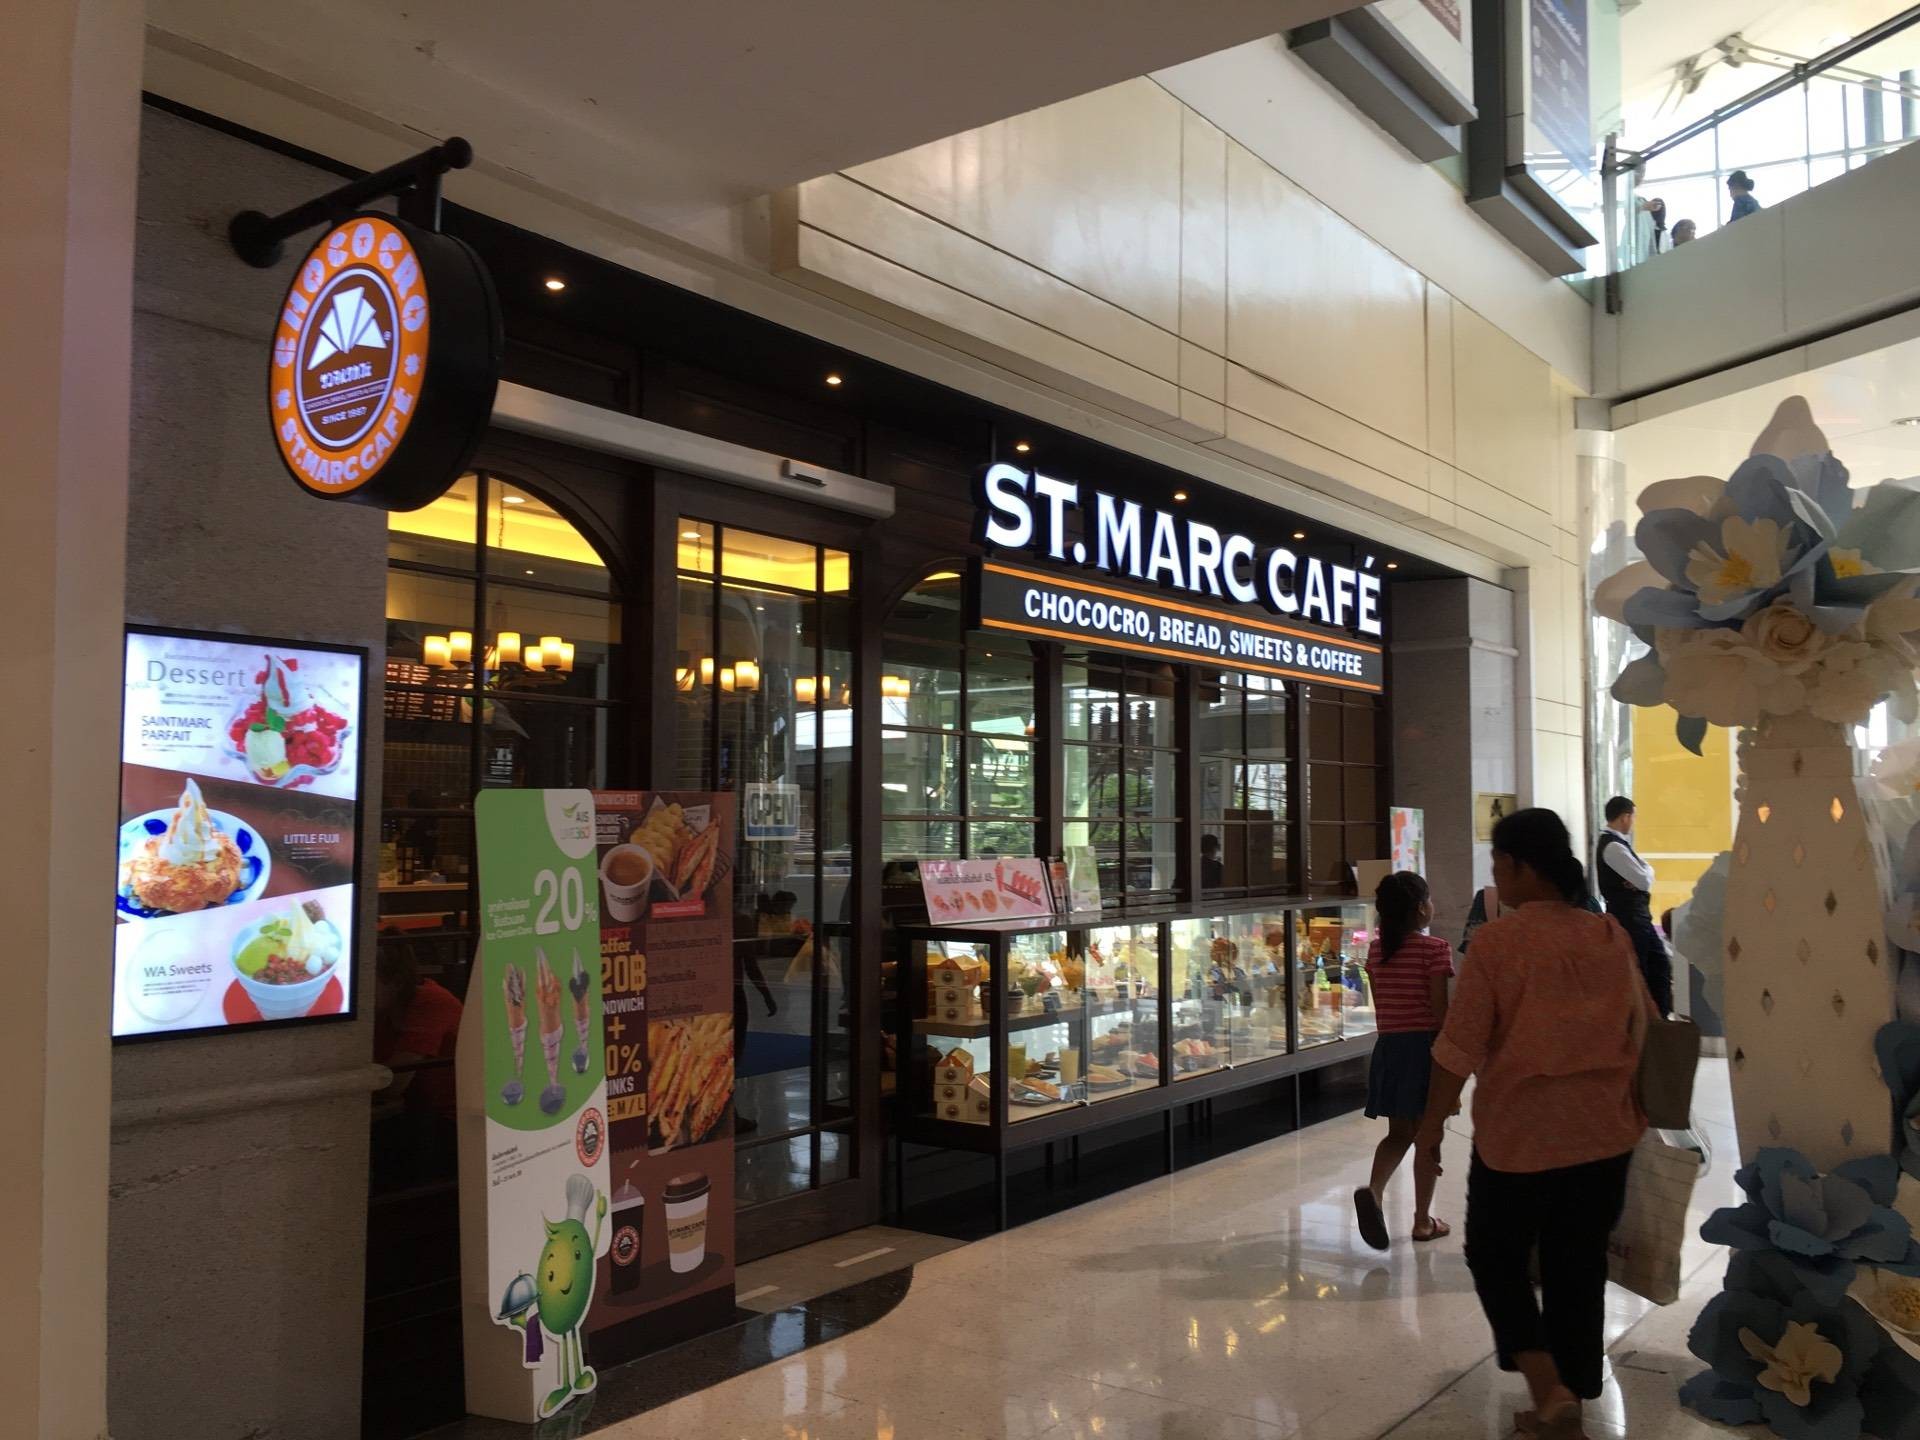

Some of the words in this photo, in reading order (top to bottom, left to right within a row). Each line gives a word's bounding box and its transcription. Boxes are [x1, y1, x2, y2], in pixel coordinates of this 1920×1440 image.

[274, 223, 426, 368] CHOCOCRO
[360, 387, 415, 471] CAFÉ
[1267, 548, 1383, 637] CAFÉ
[1024, 588, 1156, 643] CHOCOCRO,
[1159, 614, 1228, 656] BREAD,
[1229, 629, 1293, 665] SWEETS
[1295, 642, 1309, 666] &
[1310, 644, 1362, 677] COFFEE
[146, 659, 246, 688] Dessert
[141, 715, 213, 729] SAINTMARC
[141, 729, 191, 741] PARFAIT
[284, 833, 317, 844] LITTLE
[318, 833, 341, 844] FUJI
[144, 965, 167, 978] WA
[169, 962, 213, 976] Sweets
[602, 996, 645, 1016] NDWICH
[606, 1043, 642, 1077] 0%
